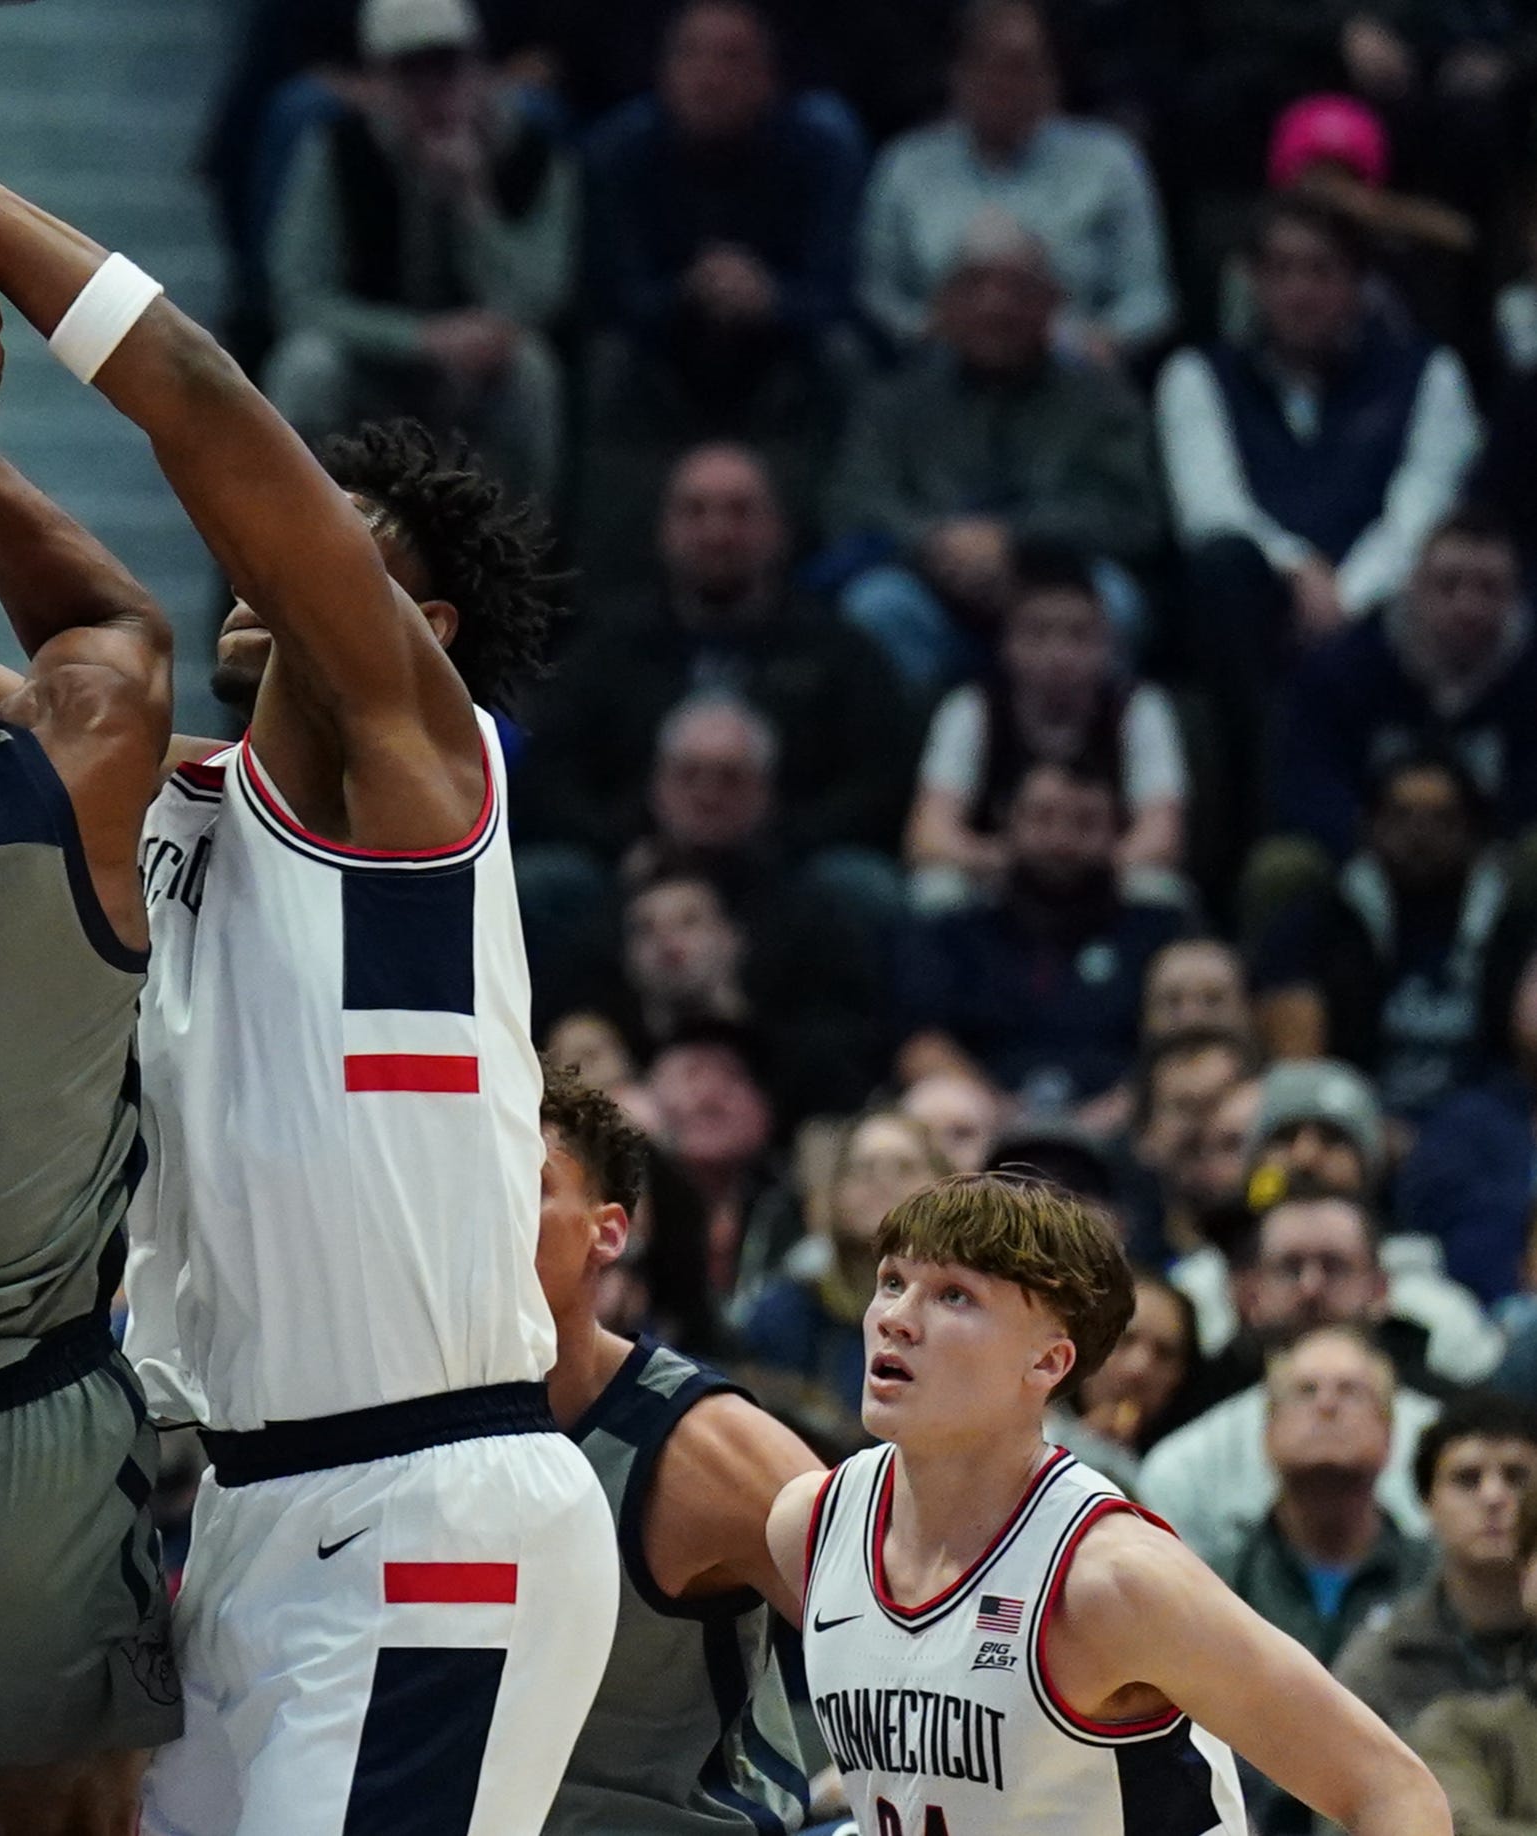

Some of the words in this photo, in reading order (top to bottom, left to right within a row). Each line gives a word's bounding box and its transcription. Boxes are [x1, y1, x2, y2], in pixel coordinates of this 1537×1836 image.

[979, 1641, 1011, 1655] BIG
[974, 1653, 1018, 1667] EAST
[815, 1688, 1005, 1791] CONNECTICUT
